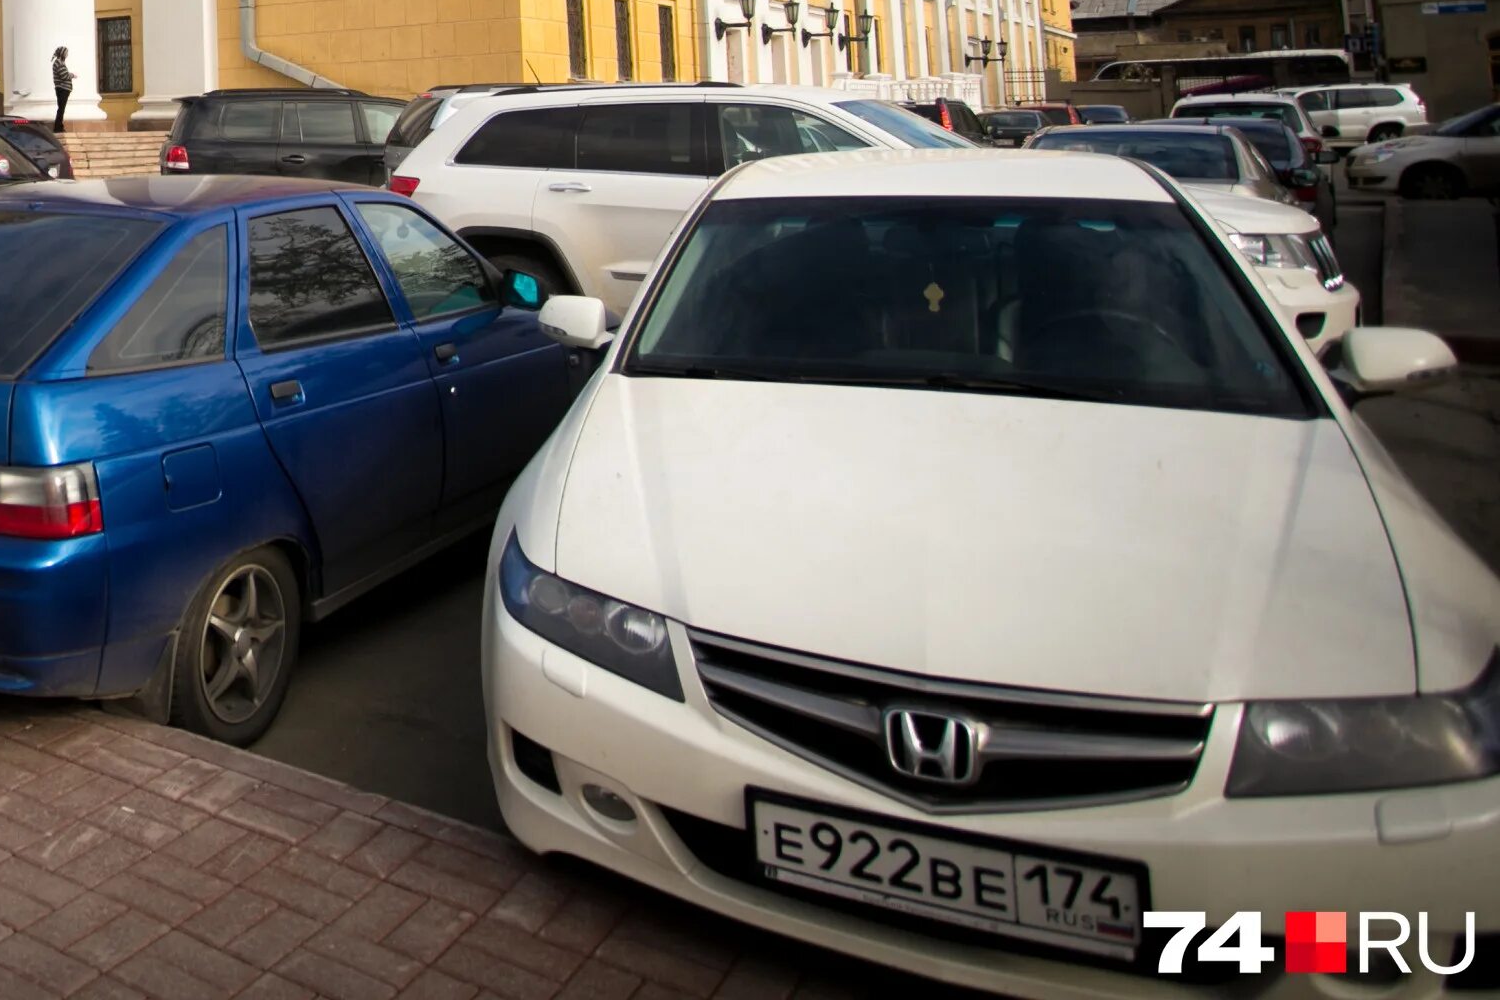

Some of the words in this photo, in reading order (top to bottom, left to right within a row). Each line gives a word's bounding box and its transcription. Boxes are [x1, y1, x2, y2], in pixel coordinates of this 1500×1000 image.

[774, 821, 1007, 912] Е922ВЕ
[1024, 864, 1122, 920] 174
[1046, 906, 1096, 932] RUS
